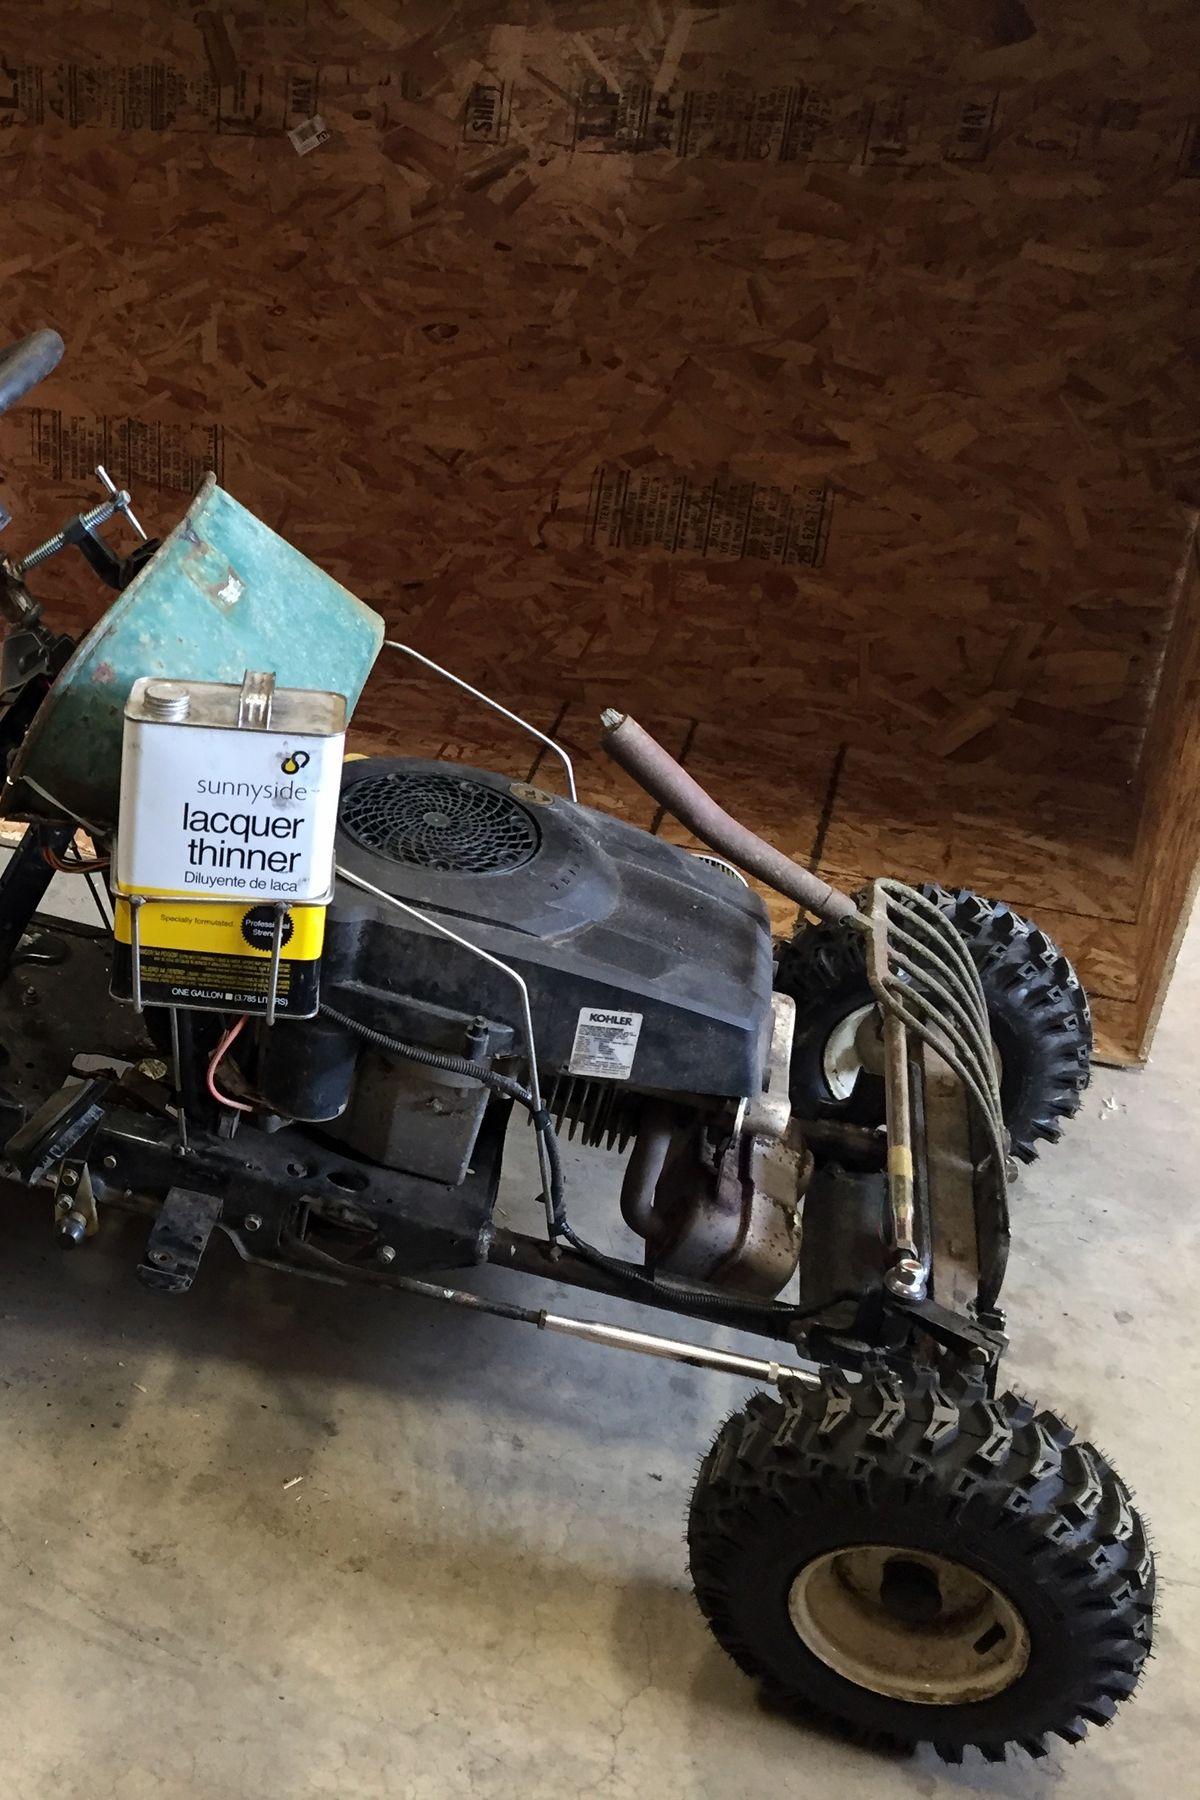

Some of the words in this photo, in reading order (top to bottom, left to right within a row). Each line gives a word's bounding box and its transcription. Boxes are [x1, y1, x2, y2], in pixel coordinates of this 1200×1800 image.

[471, 83, 497, 132] SHIFT
[197, 780, 308, 804] sunnyside
[183, 803, 305, 843] lacquer
[188, 838, 301, 873] thinner
[184, 871, 246, 888] Diluyente
[250, 876, 266, 889] de
[270, 878, 298, 892] laca
[160, 913, 192, 925] Specially
[195, 917, 234, 928] formulated
[171, 987, 189, 997] ONE
[191, 989, 224, 999] GALLON
[234, 993, 257, 1003] (3.785
[257, 996, 289, 1007] LITRS)
[589, 1012, 632, 1026] KOHLER
